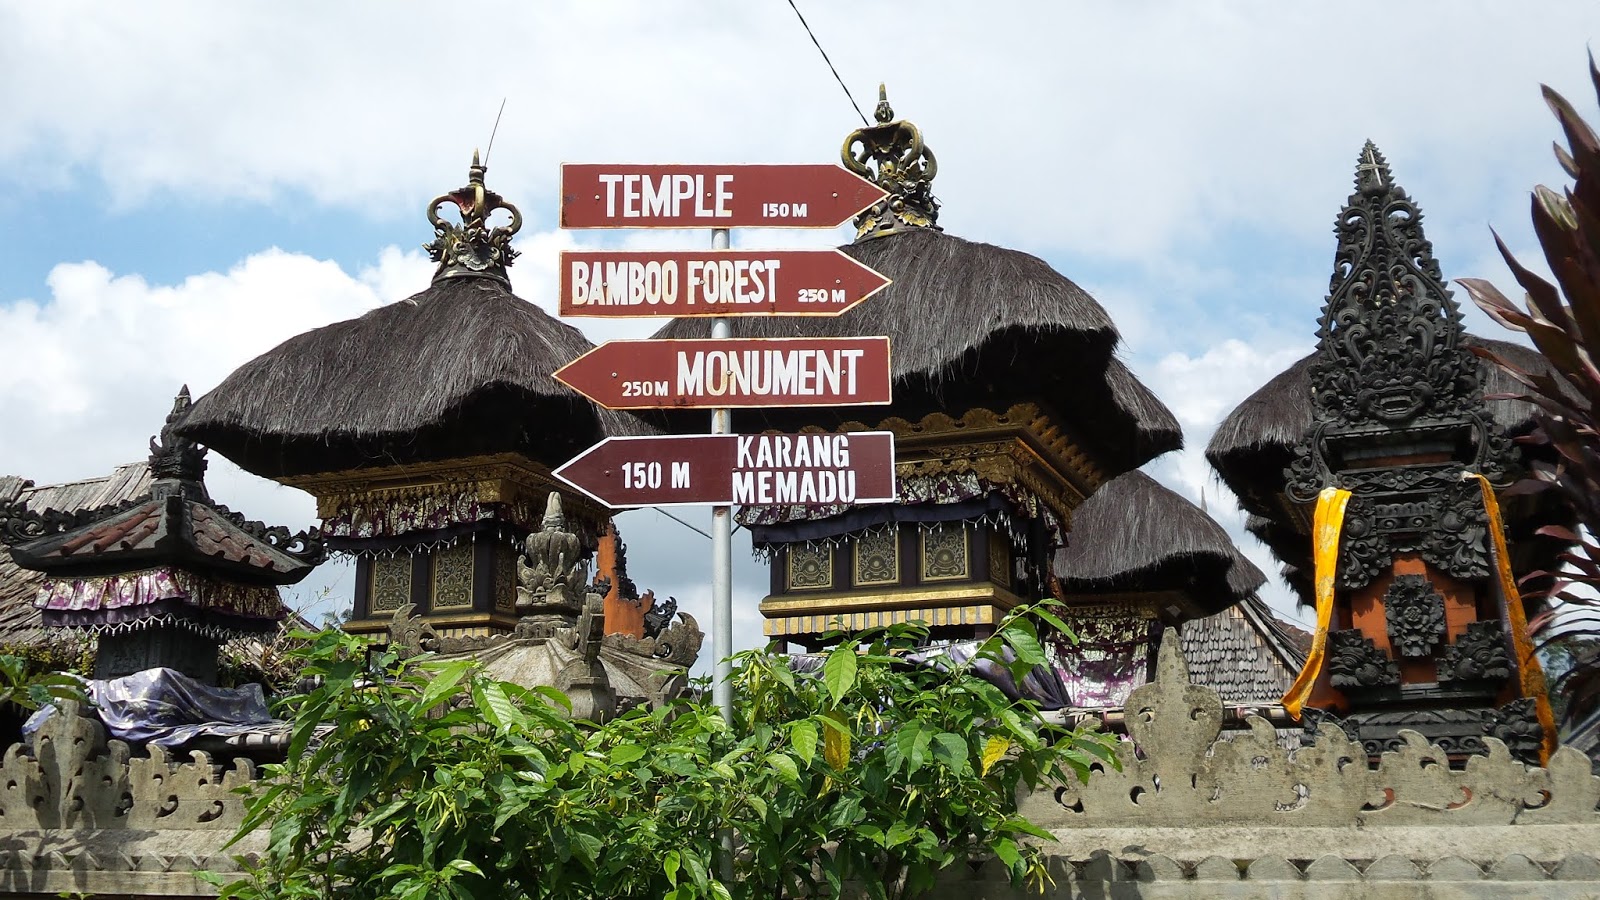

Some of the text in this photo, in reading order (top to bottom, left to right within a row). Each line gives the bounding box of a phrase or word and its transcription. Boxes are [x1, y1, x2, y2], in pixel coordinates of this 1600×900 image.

[599, 174, 734, 218] TEMPLE
[762, 203, 808, 218] 150 M
[571, 259, 781, 306] BAMBOO FOREST
[797, 288, 846, 303] 250 M
[676, 349, 864, 396] MONUMENT
[736, 434, 850, 468] KARANG
[621, 461, 691, 489] 150 M
[731, 470, 856, 504] MEMADU
